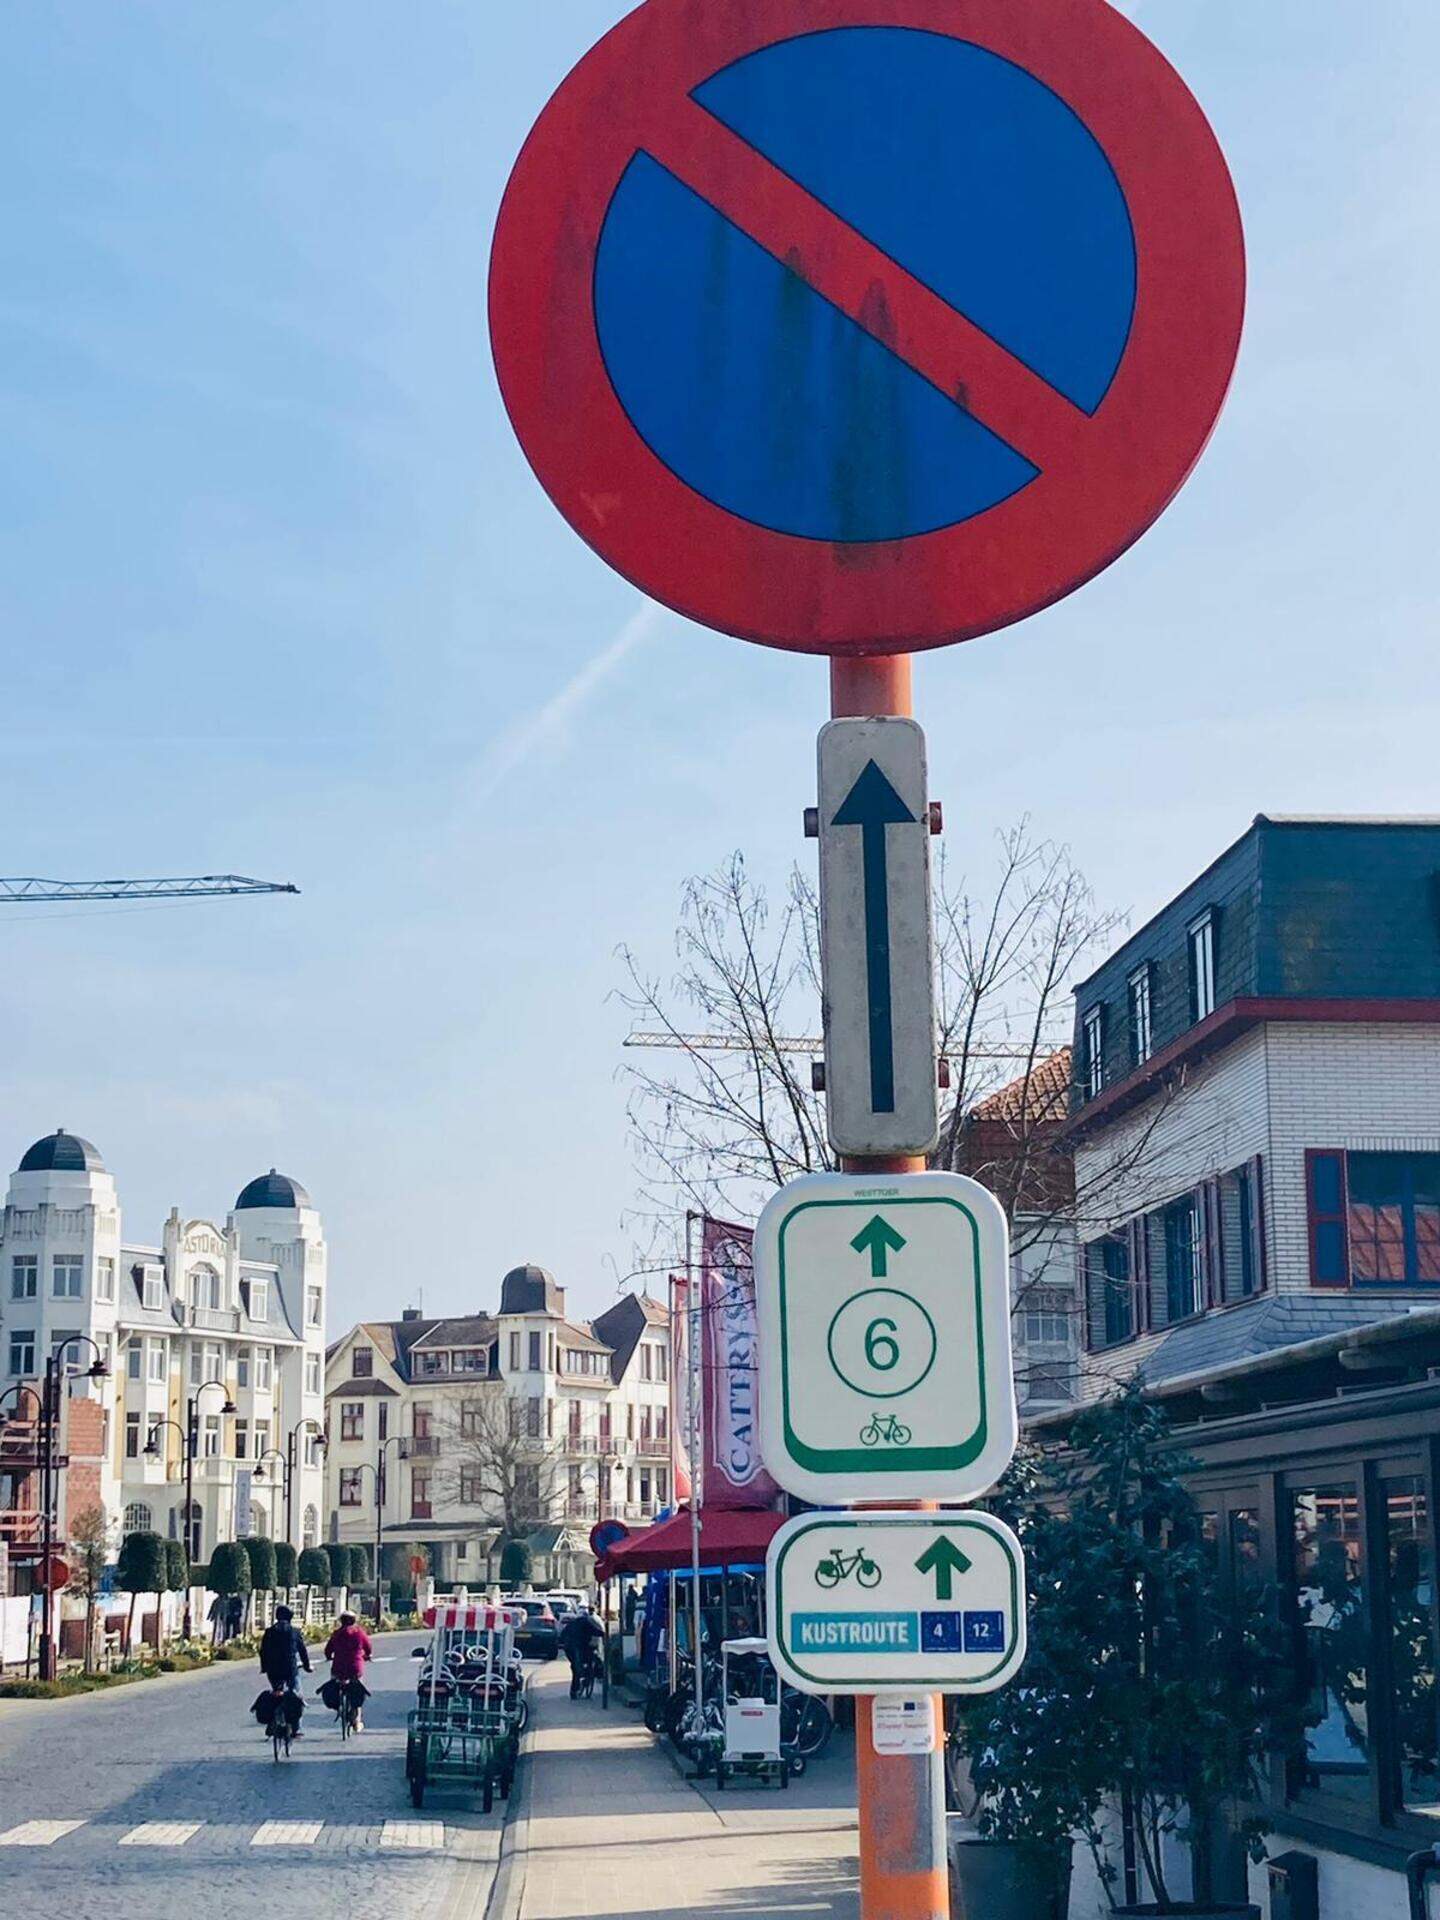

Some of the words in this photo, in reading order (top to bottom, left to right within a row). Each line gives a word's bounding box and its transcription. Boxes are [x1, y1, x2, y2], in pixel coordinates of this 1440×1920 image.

[184, 1234, 226, 1257] ASTORIA
[864, 1317, 899, 1370] 6
[801, 1620, 909, 1645] KUSTROUTE
[933, 1622, 943, 1638] 4
[972, 1622, 990, 1638] 12
